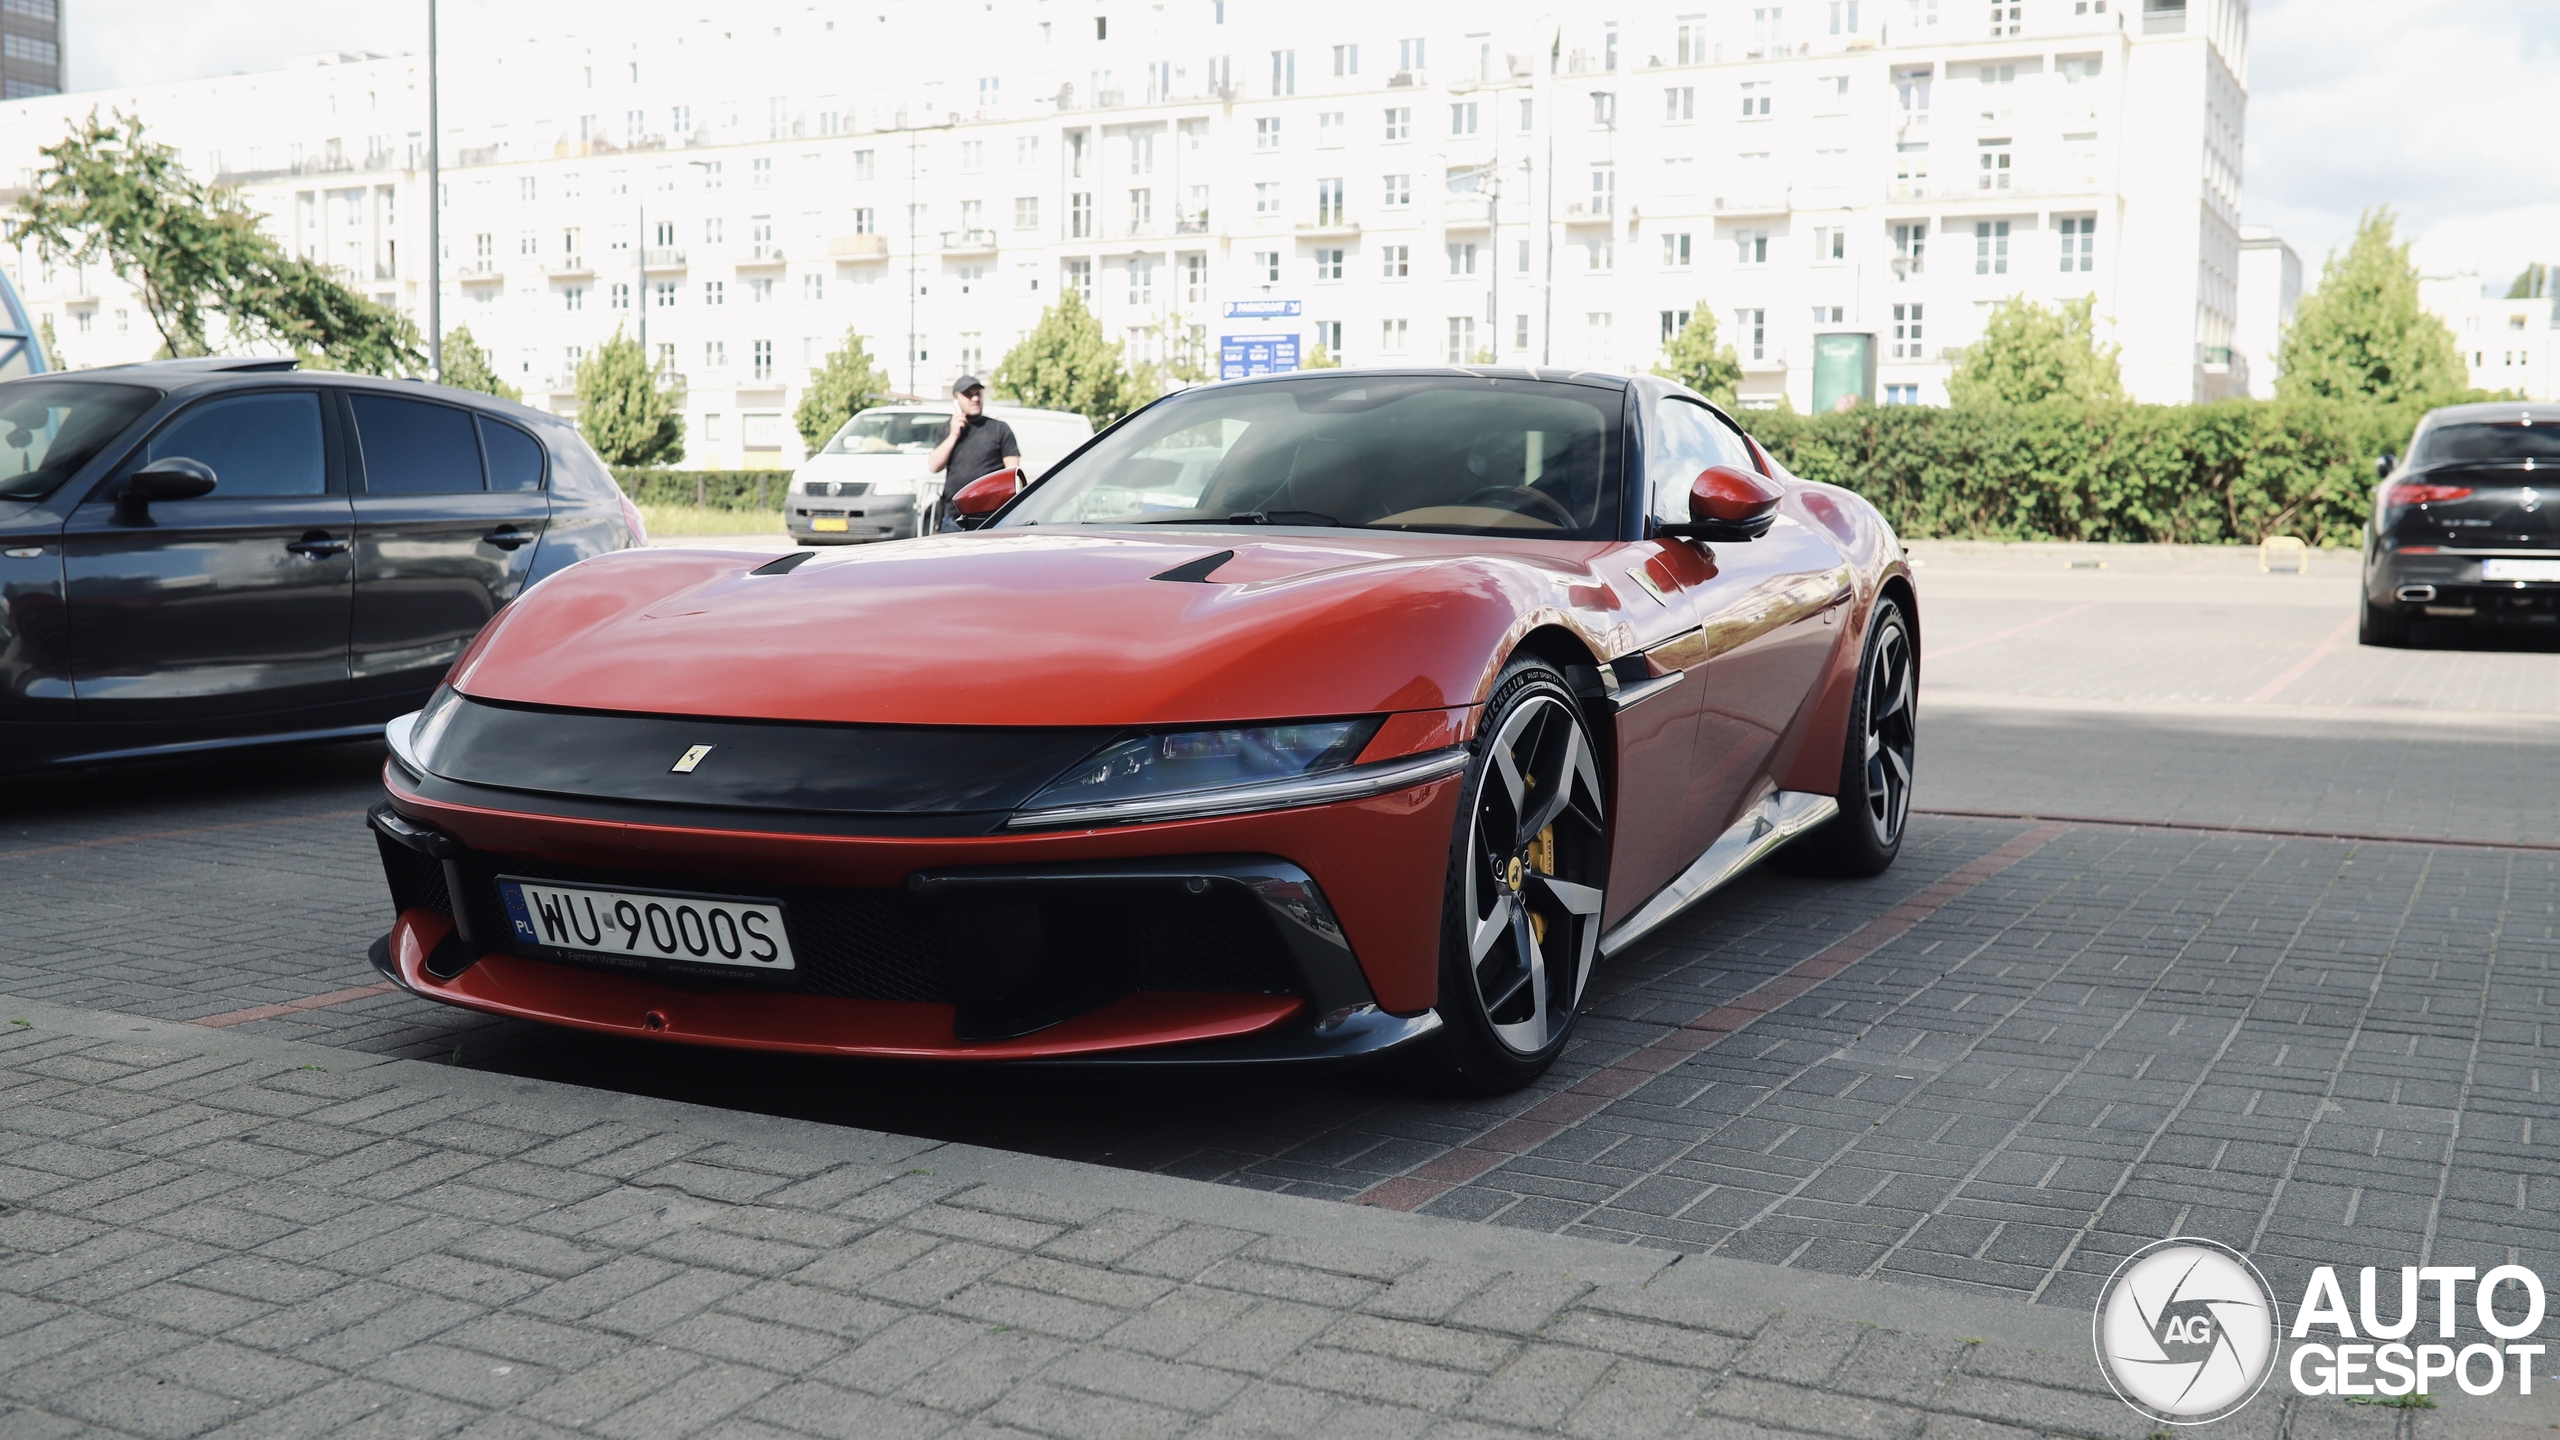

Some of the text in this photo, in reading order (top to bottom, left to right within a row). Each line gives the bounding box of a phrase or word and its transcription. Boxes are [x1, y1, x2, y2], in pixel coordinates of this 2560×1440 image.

[1481, 674, 1525, 732] MICHELIN
[515, 919, 534, 935] PL
[532, 891, 778, 963] WU 9000S
[567, 951, 647, 968] Ferrari Warszawa
[699, 968, 727, 976] FERRARI
